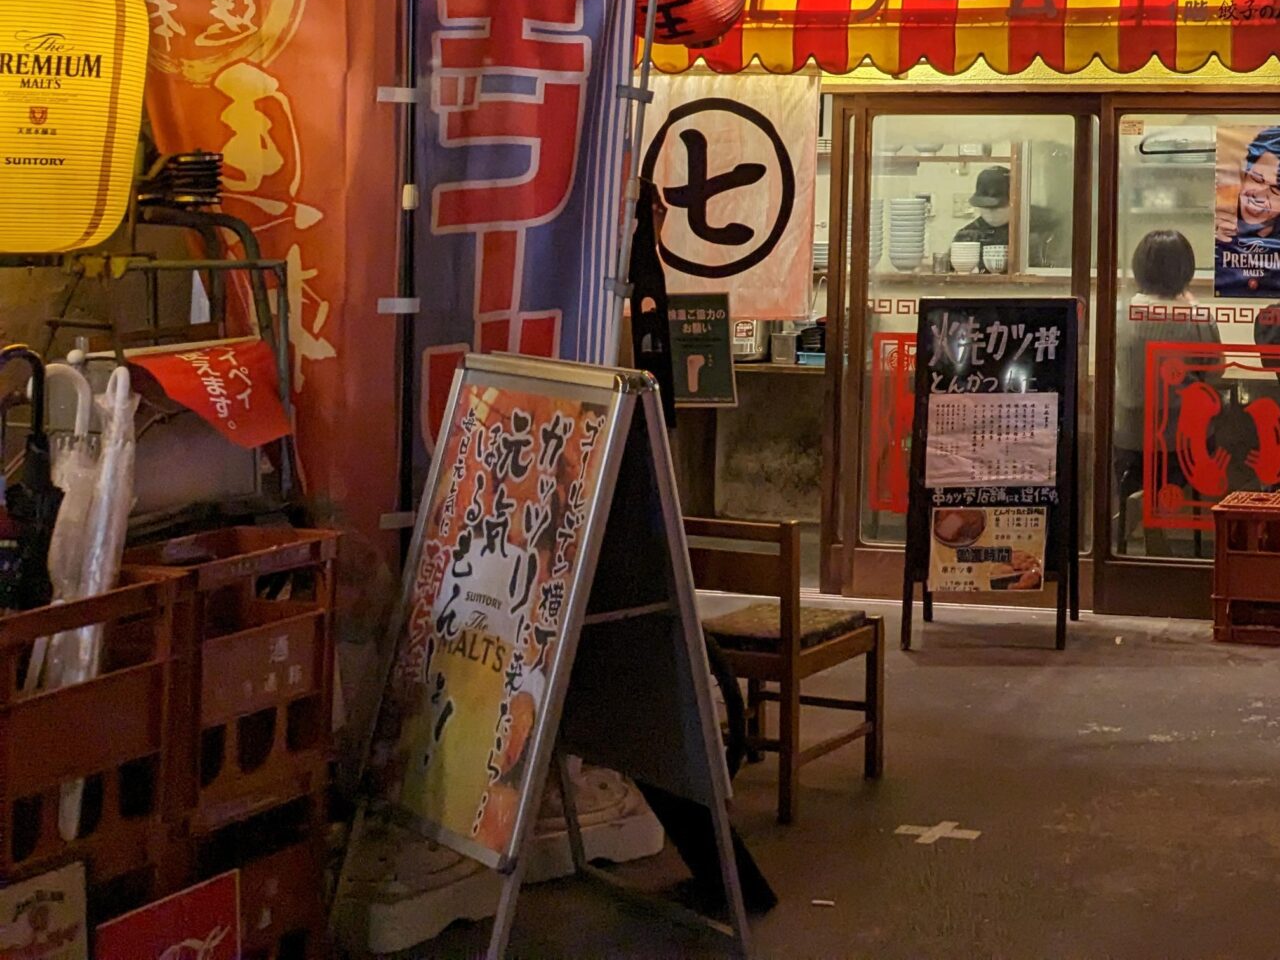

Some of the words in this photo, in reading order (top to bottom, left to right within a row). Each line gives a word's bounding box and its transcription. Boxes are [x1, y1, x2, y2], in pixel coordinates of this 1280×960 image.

[15, 30, 75, 52] The
[0, 52, 102, 78] REMIUM
[20, 77, 61, 89] MALT'S
[5, 156, 66, 167] SUNTORY
[1238, 240, 1269, 253] The
[1243, 269, 1264, 277] MALT'S
[480, 409, 535, 558] 元気
[508, 413, 574, 614] ガッツリ
[465, 591, 503, 611] SUNTORY
[465, 610, 490, 632] The
